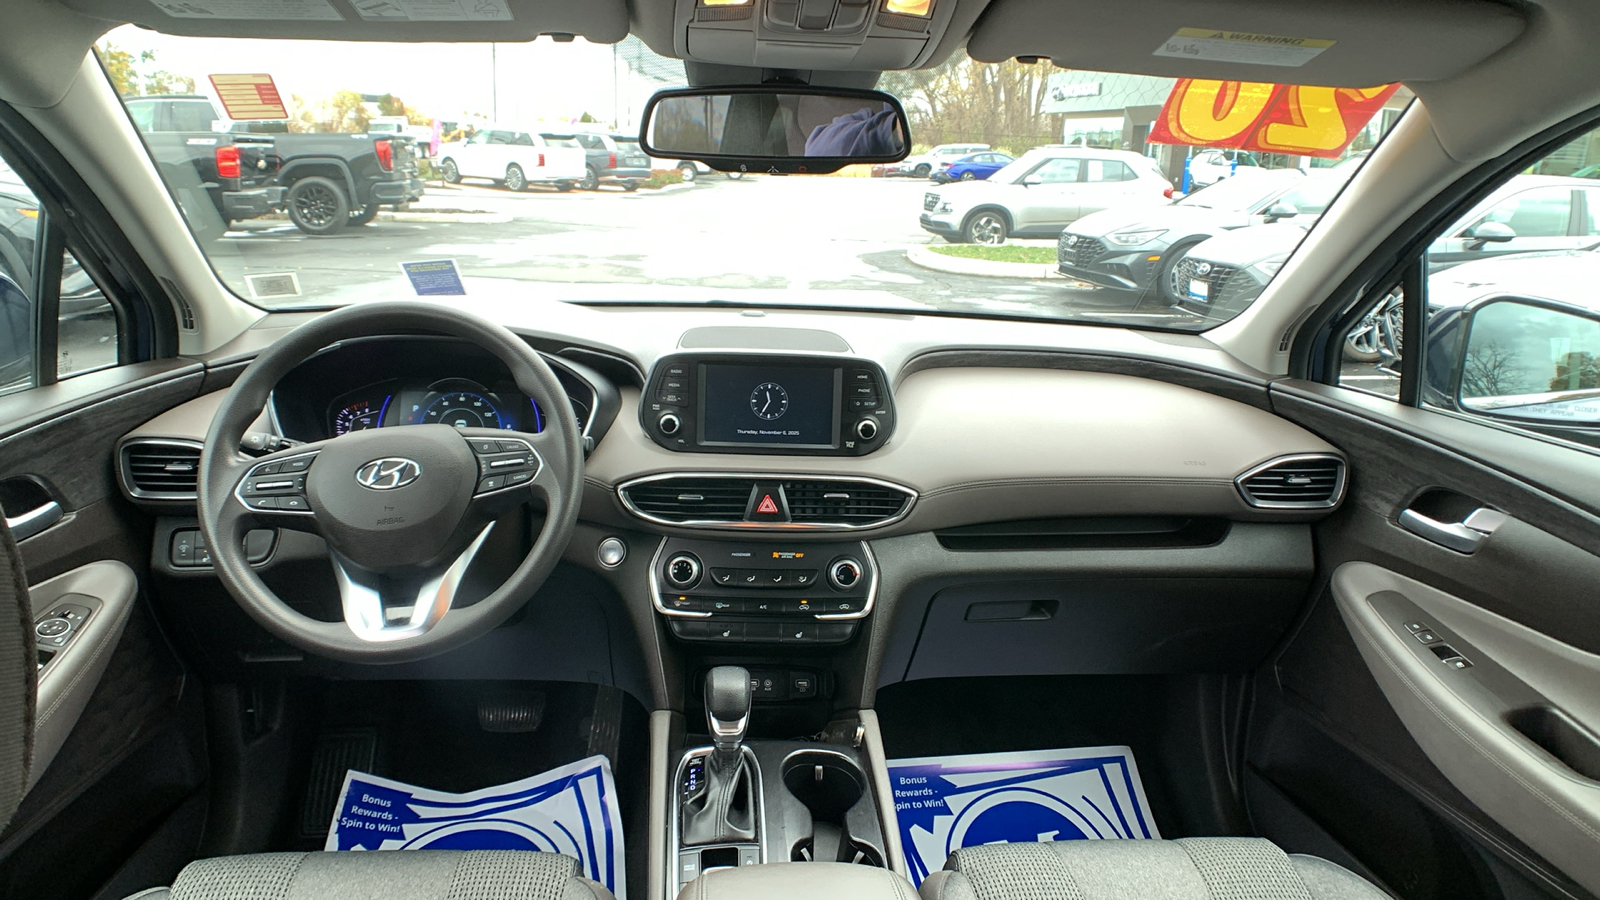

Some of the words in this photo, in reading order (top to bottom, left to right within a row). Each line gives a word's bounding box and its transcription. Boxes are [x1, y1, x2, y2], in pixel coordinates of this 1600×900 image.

[1229, 32, 1305, 45] WARNING
[412, 404, 419, 412] P
[376, 516, 405, 526] AIRBAG
[899, 776, 927, 785] Bonus
[895, 788, 933, 798] Rewards
[361, 794, 391, 807] Bonus
[912, 801, 922, 809] to
[923, 799, 944, 808] Win!
[351, 805, 393, 820] Rewards
[341, 817, 362, 828] Spin
[364, 822, 376, 830] to
[377, 823, 400, 833] Win!
